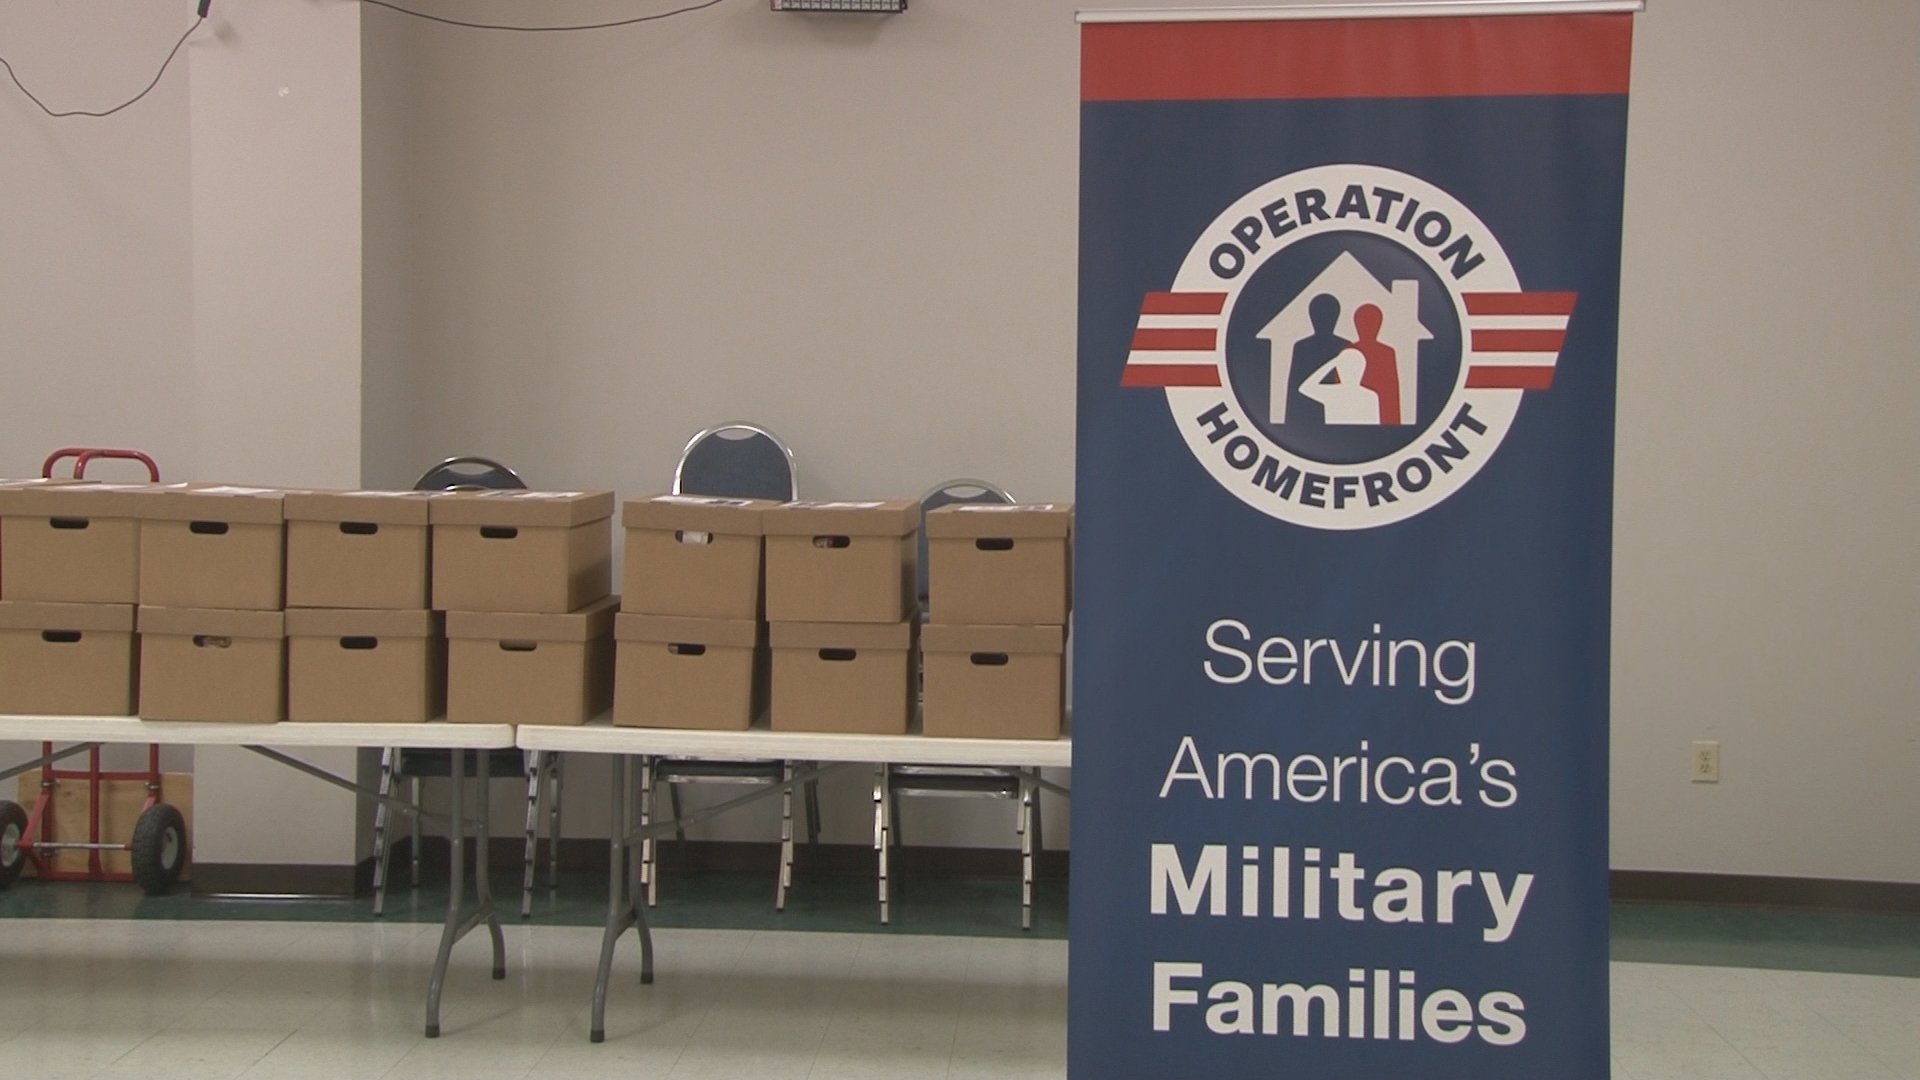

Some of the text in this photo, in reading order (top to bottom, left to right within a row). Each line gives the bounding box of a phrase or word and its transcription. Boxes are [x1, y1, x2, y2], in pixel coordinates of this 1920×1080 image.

[1208, 184, 1486, 280] OPERATION
[1196, 402, 1489, 509] HOMEFRONT
[1203, 619, 1477, 705] Serving
[1159, 736, 1518, 808] America's
[1150, 843, 1534, 943] Military
[1153, 961, 1527, 1046] Families
